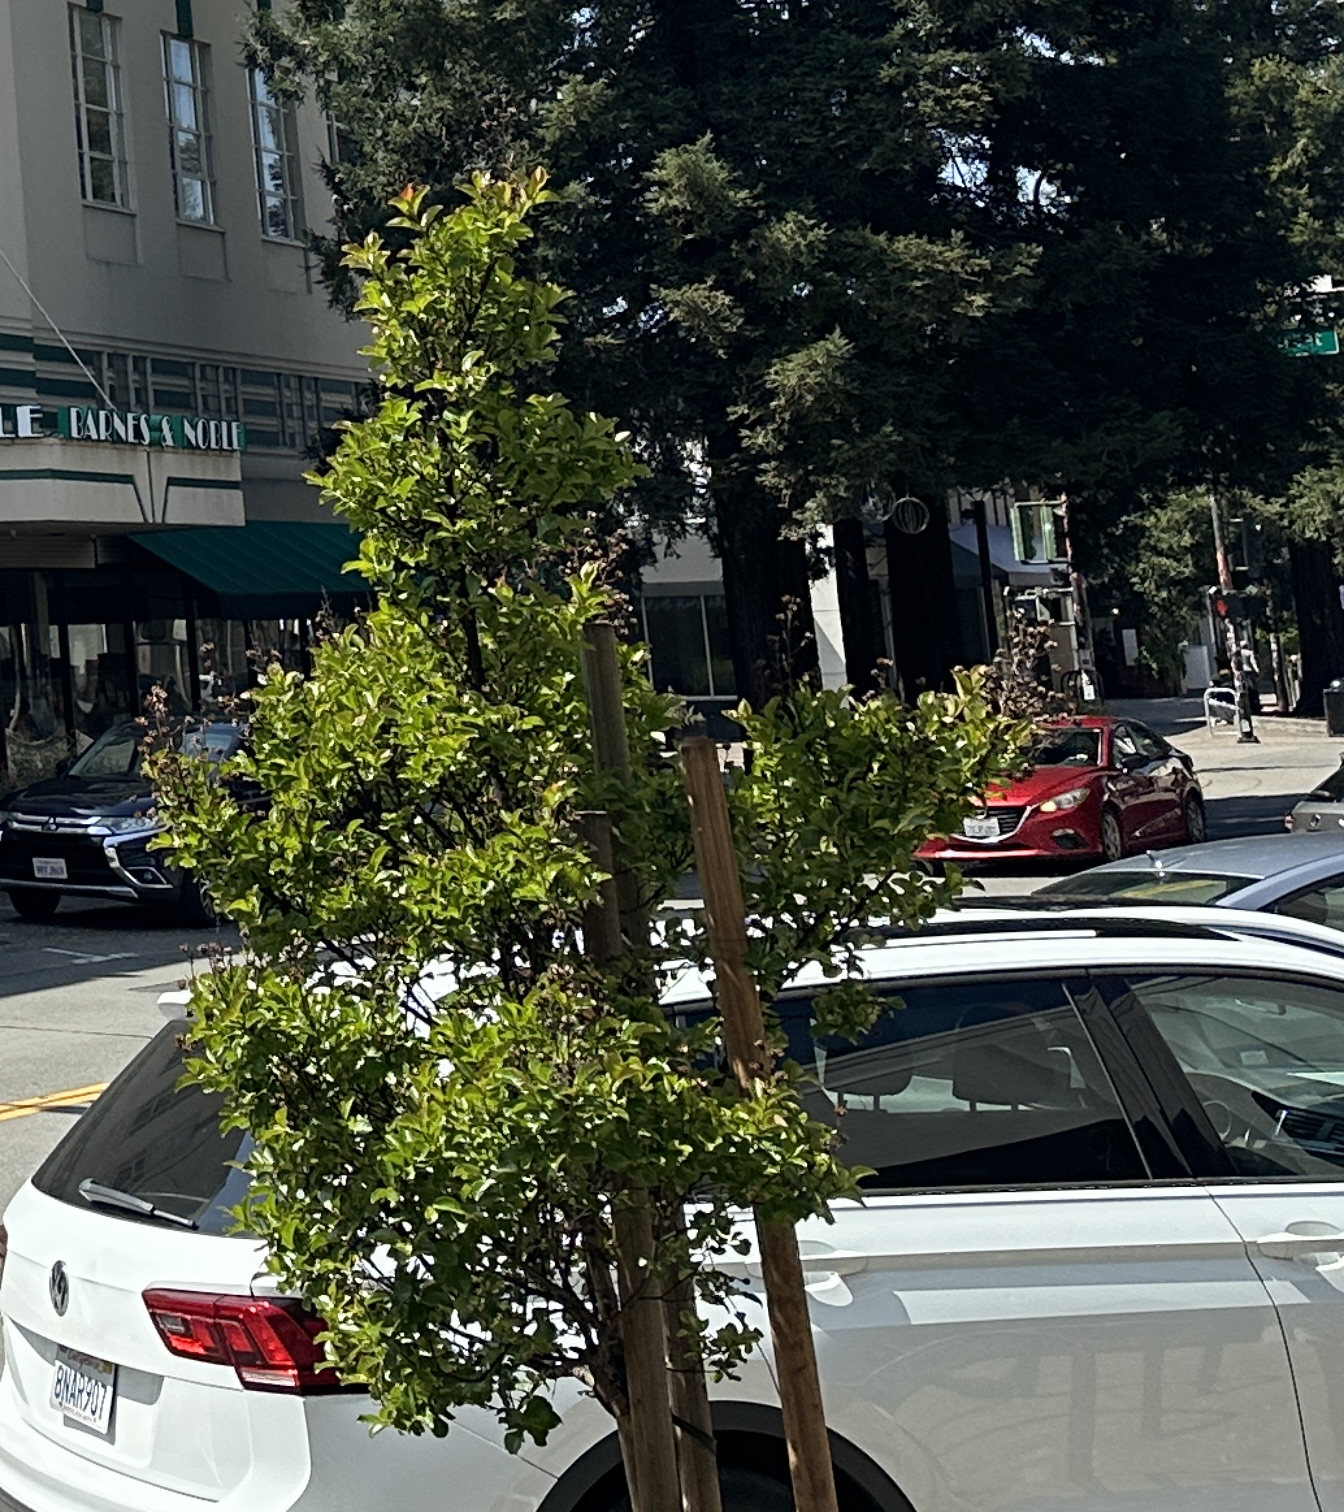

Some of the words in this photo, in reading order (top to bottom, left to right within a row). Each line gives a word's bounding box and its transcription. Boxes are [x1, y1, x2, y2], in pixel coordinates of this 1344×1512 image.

[69, 406, 151, 446] BARNES
[161, 415, 175, 447] &
[183, 417, 242, 450] NOBLE
